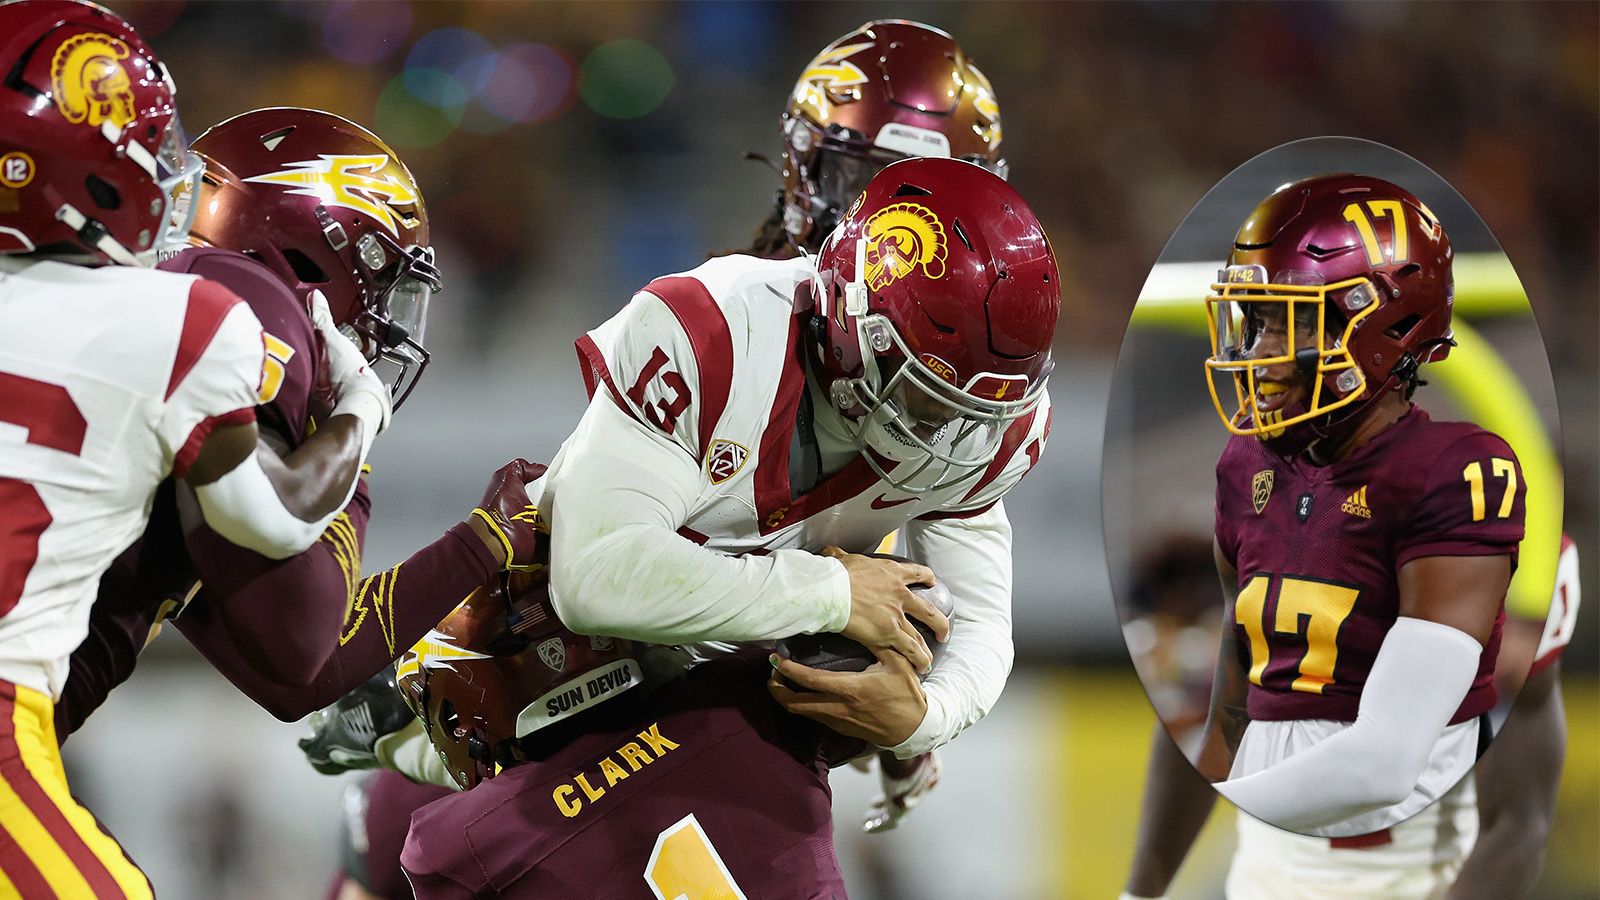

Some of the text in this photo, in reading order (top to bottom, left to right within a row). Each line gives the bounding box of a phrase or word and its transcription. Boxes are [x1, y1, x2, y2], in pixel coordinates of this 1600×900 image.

[6, 158, 27, 181] 12
[1343, 200, 1410, 267] 17
[927, 358, 953, 379] USC
[626, 345, 692, 435] 13
[710, 442, 748, 472] PAC
[711, 458, 733, 477] 12
[1463, 457, 1518, 522] 17
[1341, 502, 1372, 519] adidas
[1234, 571, 1362, 695] 17
[548, 653, 562, 667] 12
[546, 664, 632, 717] SUN DEVILS
[552, 722, 681, 818] CLARK
